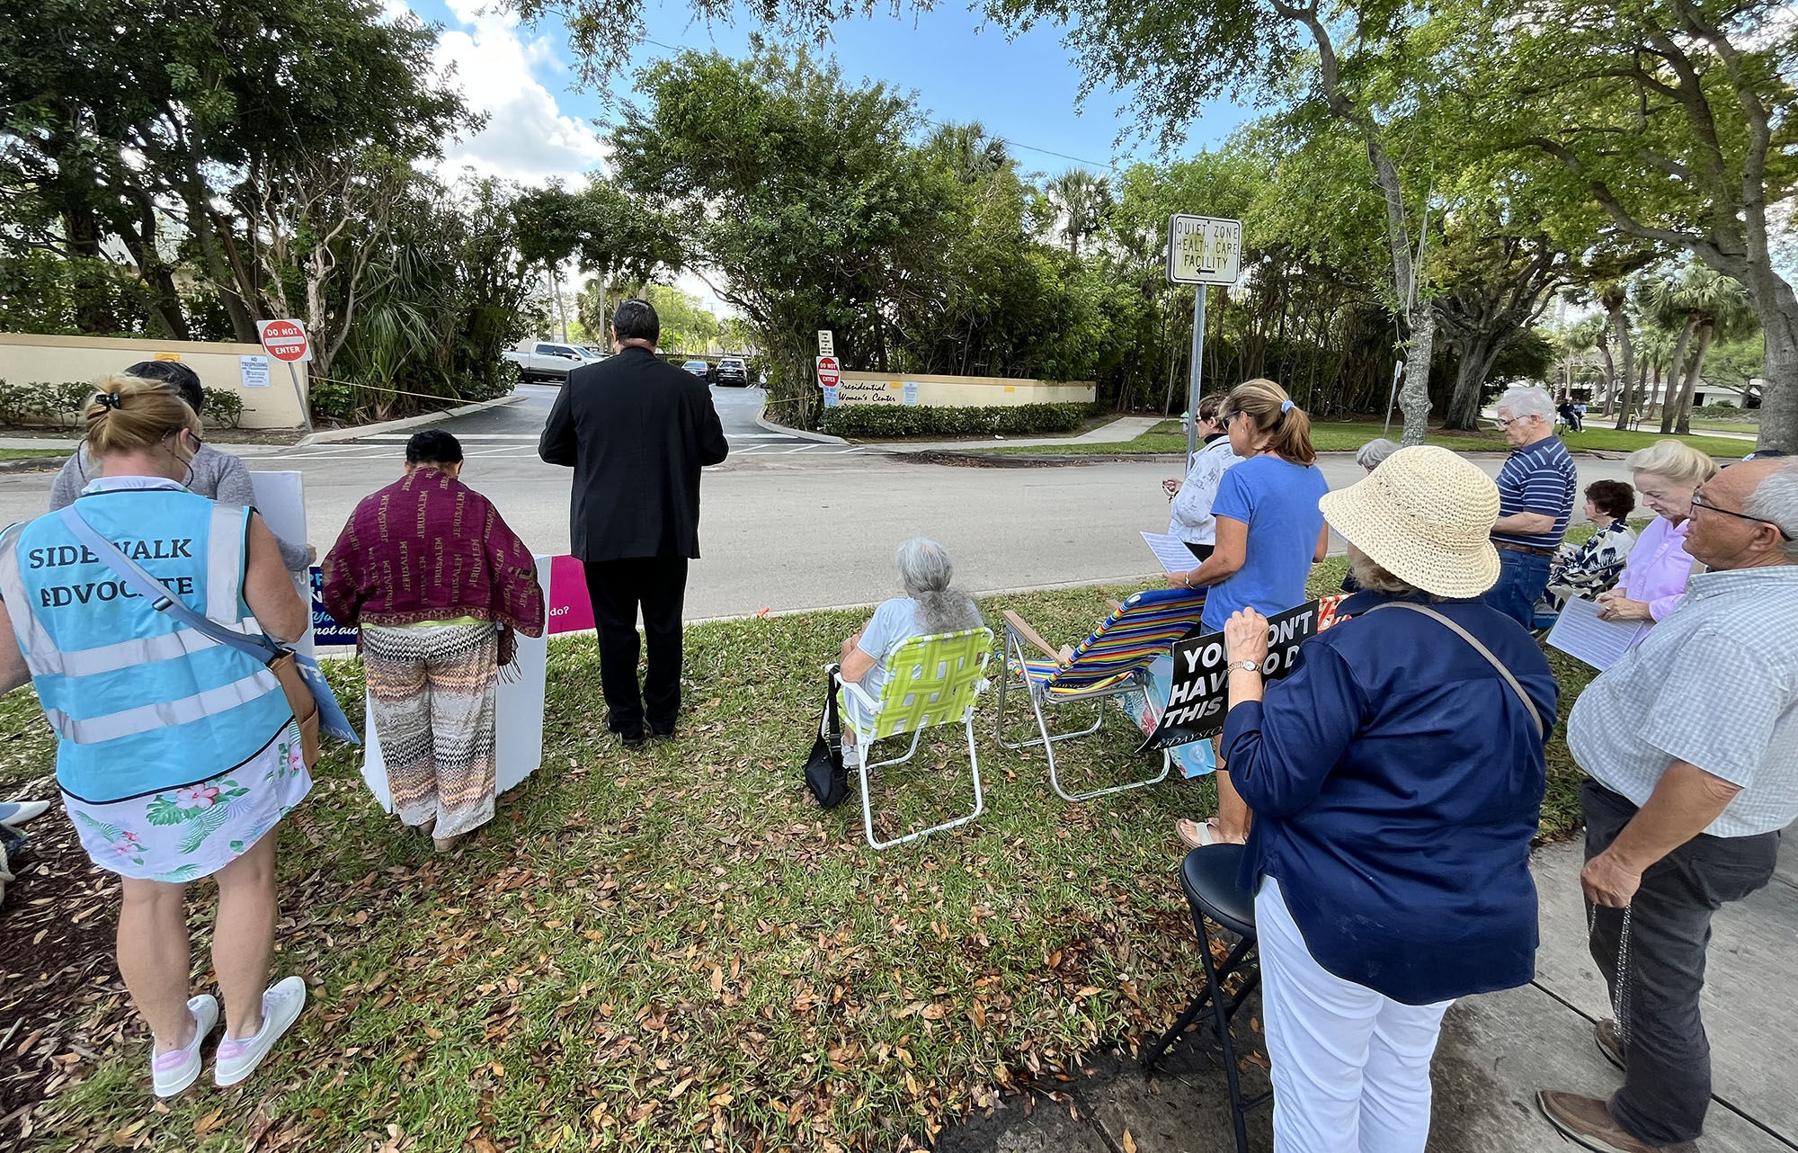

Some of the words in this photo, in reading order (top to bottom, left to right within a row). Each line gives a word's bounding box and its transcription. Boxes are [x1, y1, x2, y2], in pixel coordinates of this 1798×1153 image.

[1177, 222, 1206, 236] QUIET
[1214, 226, 1238, 239] ZONE
[1177, 239, 1209, 253] HEALTH
[1215, 242, 1237, 255] CARE
[1184, 255, 1228, 269] FACILITY
[275, 346, 300, 354] ENTER
[872, 393, 895, 401] Center
[378, 494, 390, 543] JERUSALEM
[417, 490, 428, 539] JERUSALEM
[453, 491, 465, 538] JERUSALEM
[400, 541, 411, 592] JERUSALEM
[434, 537, 444, 587] JERUSALEM
[550, 606, 569, 616] do?
[313, 625, 337, 635] not
[1183, 642, 1228, 673] YO
[1267, 611, 1313, 647] ON'T
[1168, 672, 1229, 707] HAV
[1164, 696, 1223, 729] THIS
